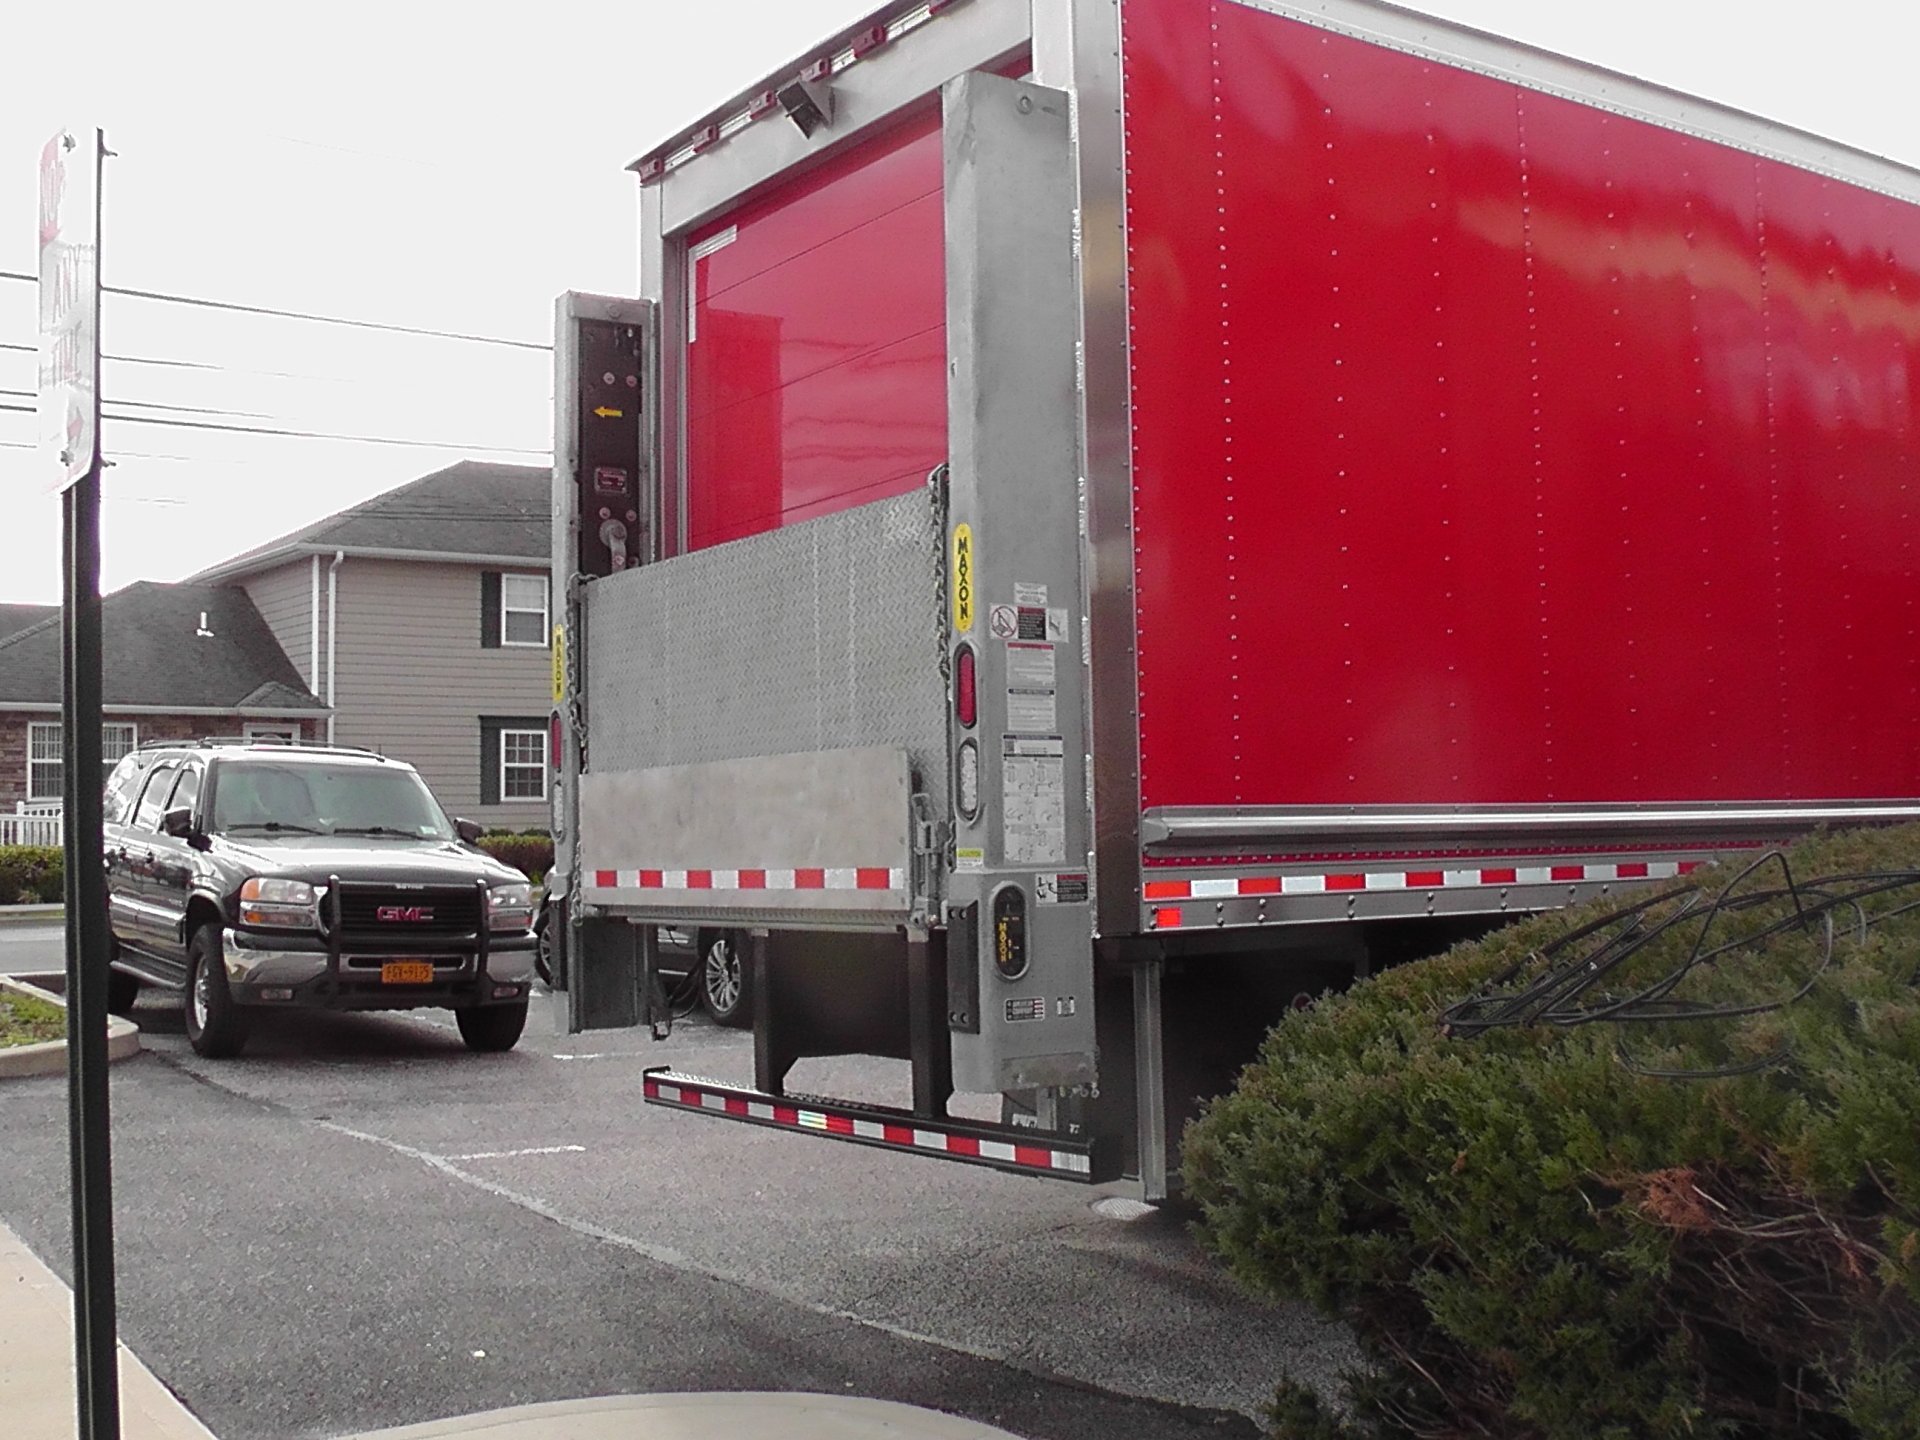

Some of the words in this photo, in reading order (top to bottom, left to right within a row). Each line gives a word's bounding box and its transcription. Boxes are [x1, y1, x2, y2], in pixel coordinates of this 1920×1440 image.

[52, 243, 81, 323] ANY
[52, 320, 82, 388] TIME
[957, 535, 969, 620] MAXON
[377, 906, 434, 920] GMC
